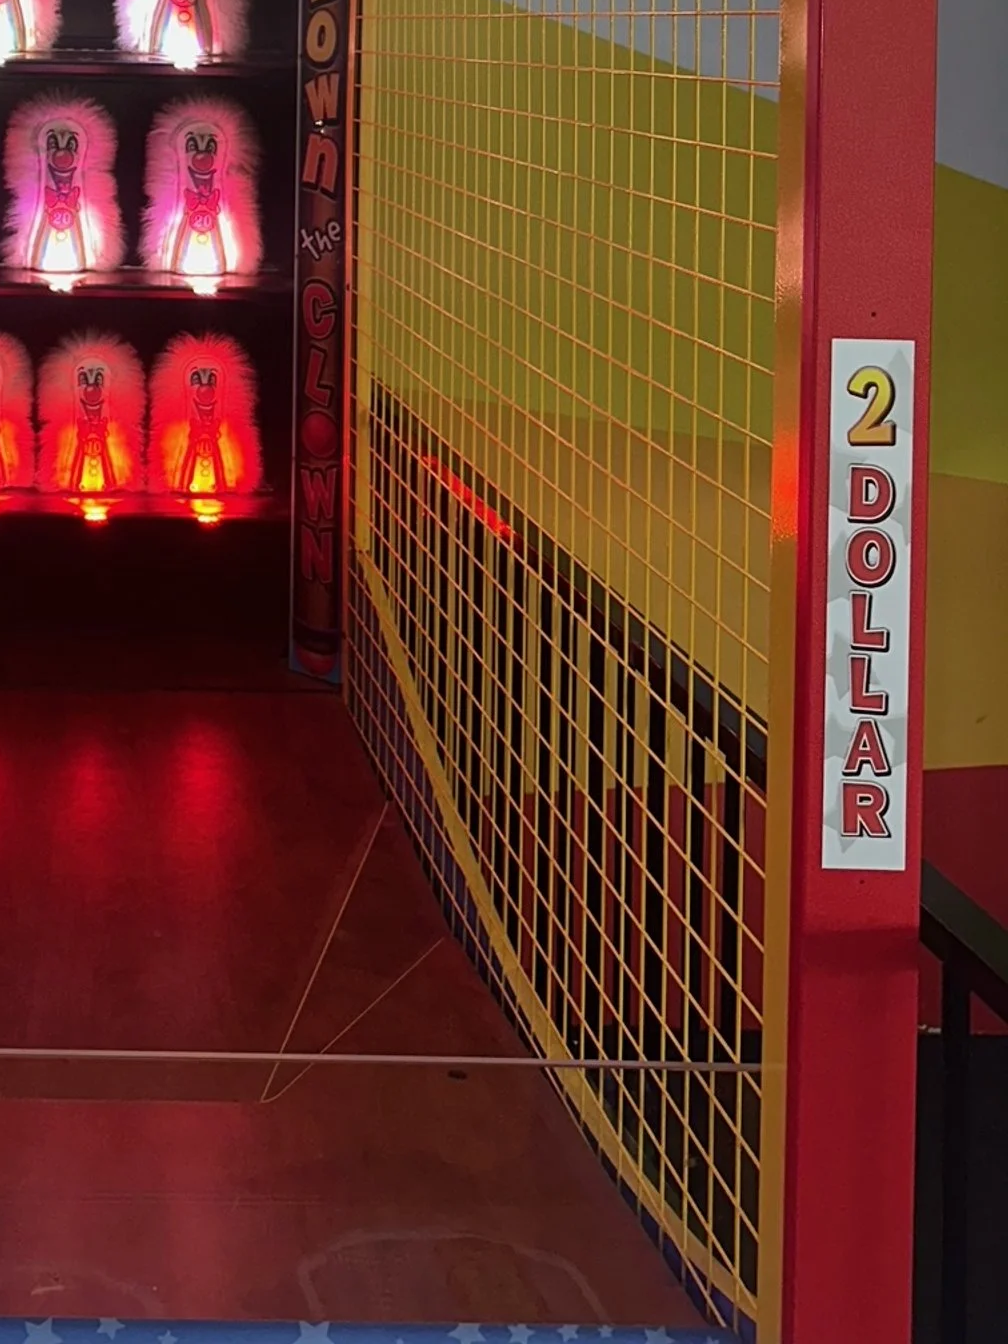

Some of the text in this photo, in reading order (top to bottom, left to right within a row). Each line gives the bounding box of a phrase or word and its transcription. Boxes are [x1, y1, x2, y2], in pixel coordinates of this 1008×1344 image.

[300, 219, 342, 261] the
[839, 365, 897, 839] 2 DOLLAR
